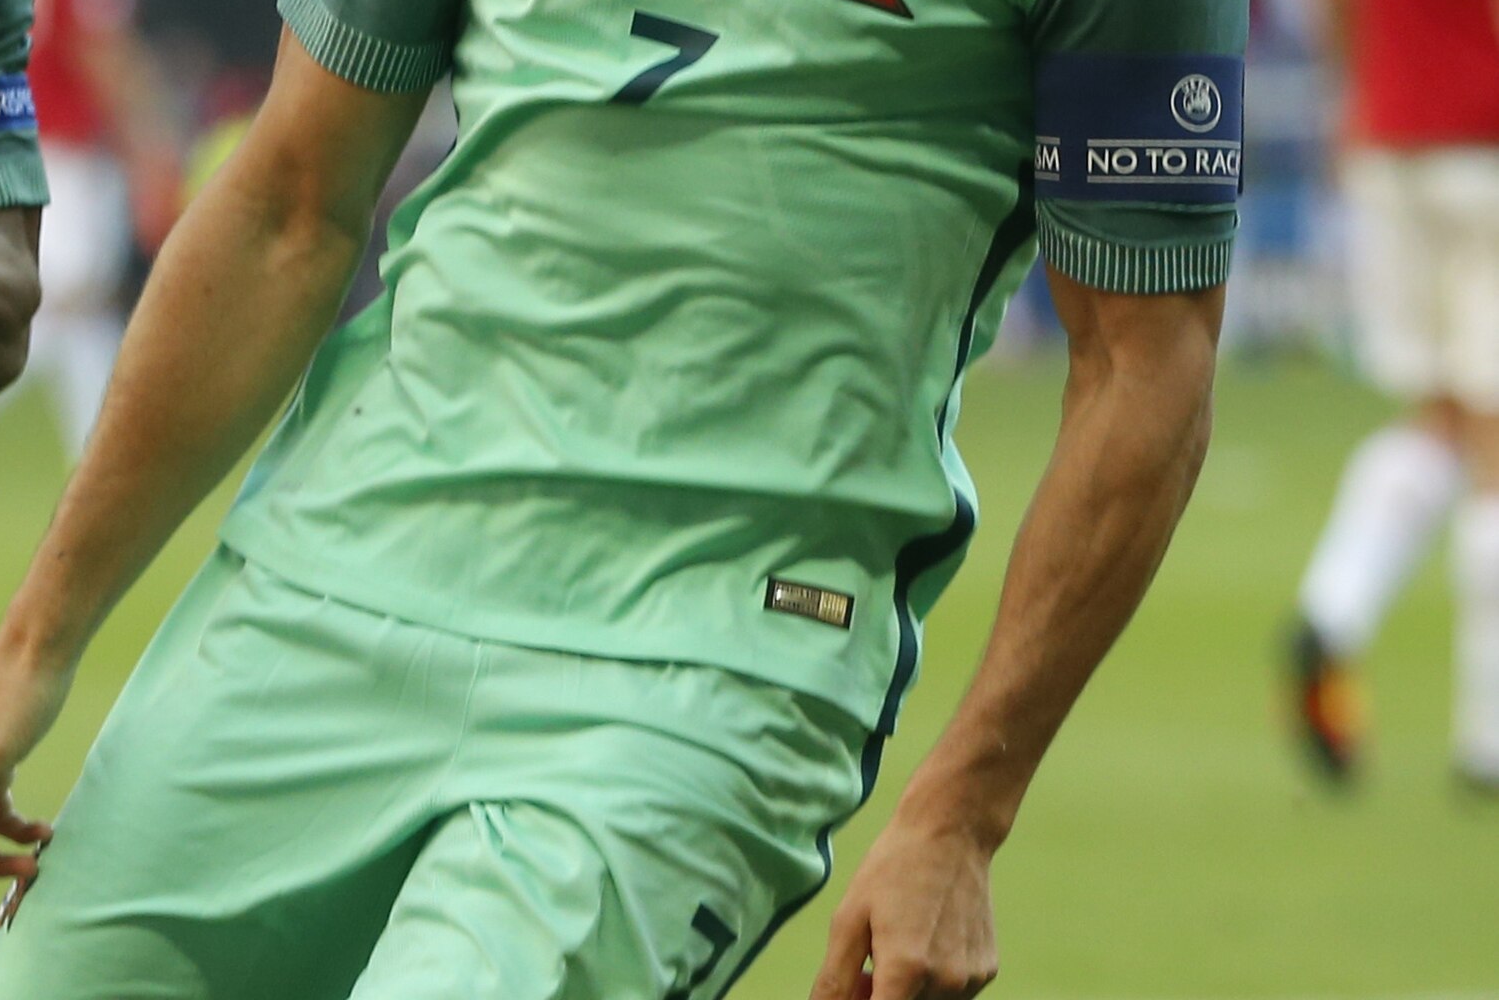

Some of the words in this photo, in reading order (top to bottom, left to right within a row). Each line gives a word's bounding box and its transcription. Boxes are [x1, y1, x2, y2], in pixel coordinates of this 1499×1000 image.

[609, 10, 719, 105] 7
[1087, 148, 1137, 175] NO
[1146, 148, 1187, 175] TO
